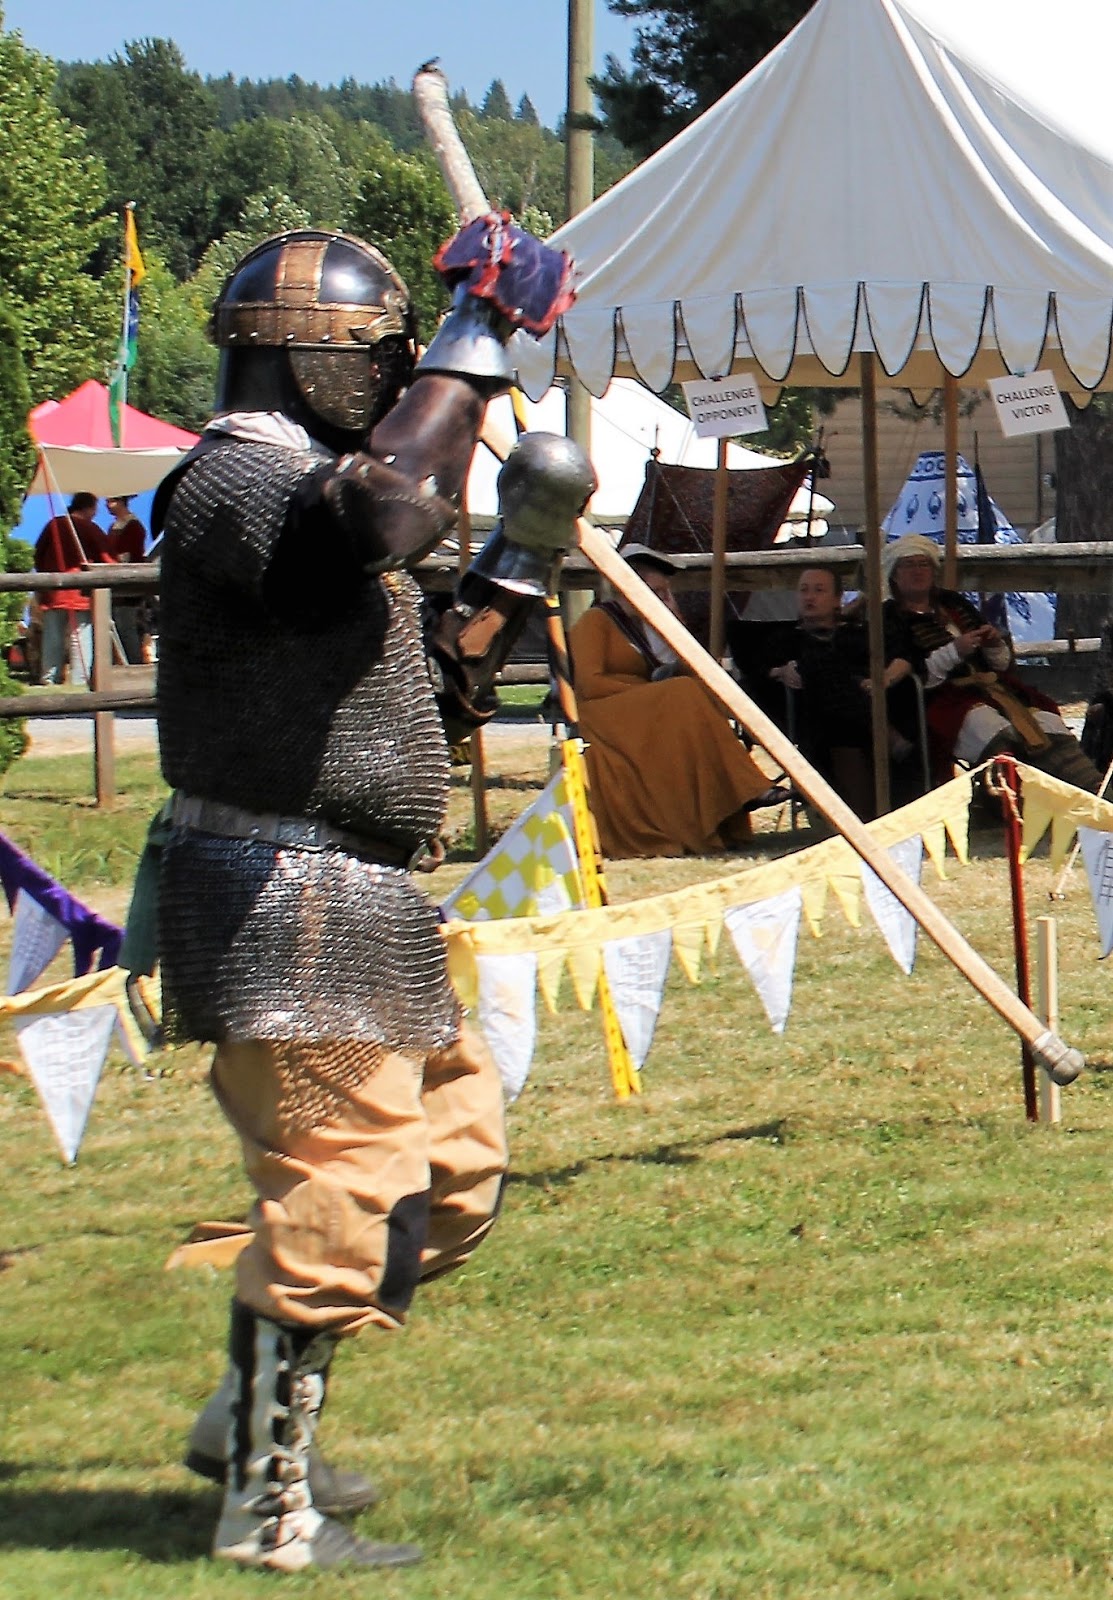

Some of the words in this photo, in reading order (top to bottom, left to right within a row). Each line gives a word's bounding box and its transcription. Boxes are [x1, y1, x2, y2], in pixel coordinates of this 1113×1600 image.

[692, 387, 756, 407] CHALLENGE
[997, 385, 1056, 404] CHALLENGE
[697, 404, 757, 423] OPPONENT
[1011, 403, 1053, 419] VICTOR
